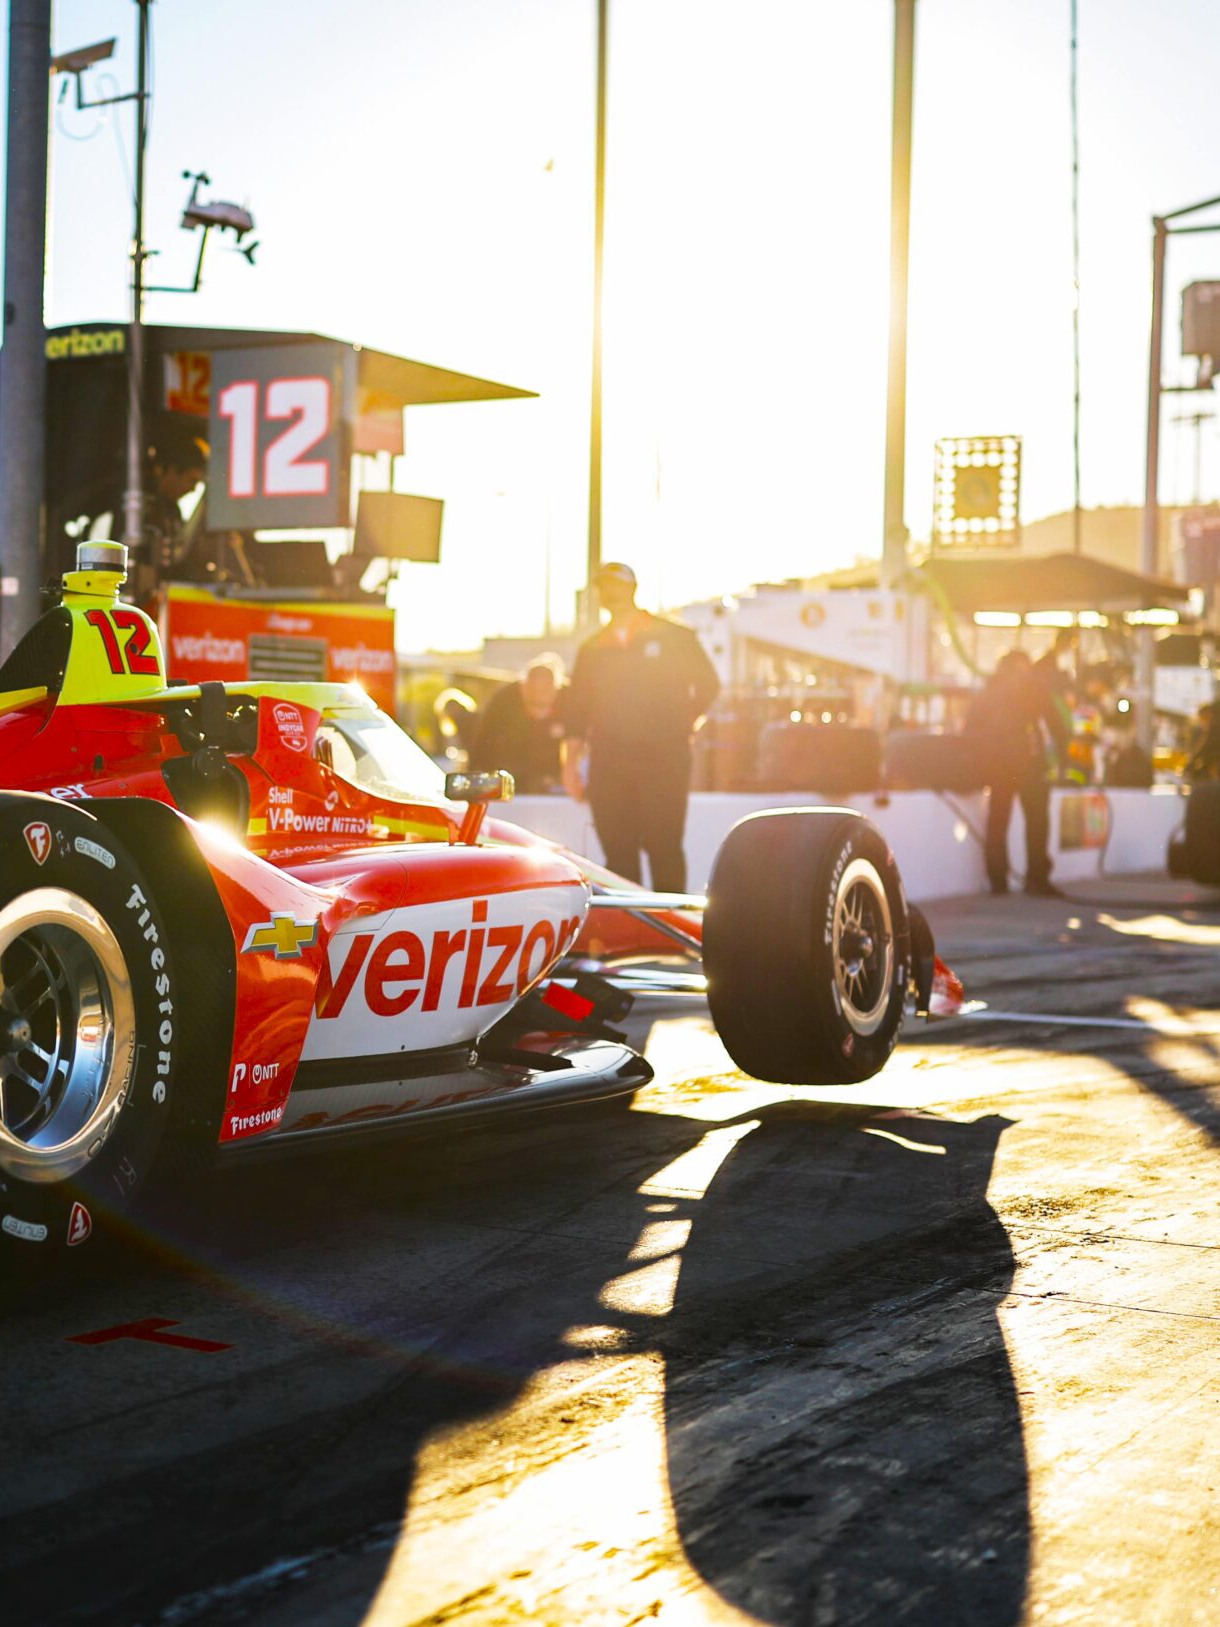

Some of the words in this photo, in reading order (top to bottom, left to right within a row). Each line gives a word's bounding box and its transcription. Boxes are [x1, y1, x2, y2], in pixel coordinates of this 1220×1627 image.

[45, 329, 125, 359] erizon
[219, 375, 330, 498] 12
[84, 608, 161, 676] 12
[172, 632, 245, 664] verizon
[269, 786, 293, 804] Shell
[269, 807, 330, 832] V-Power
[125, 883, 174, 1105] Firestone
[230, 1106, 282, 1136] Firestone
